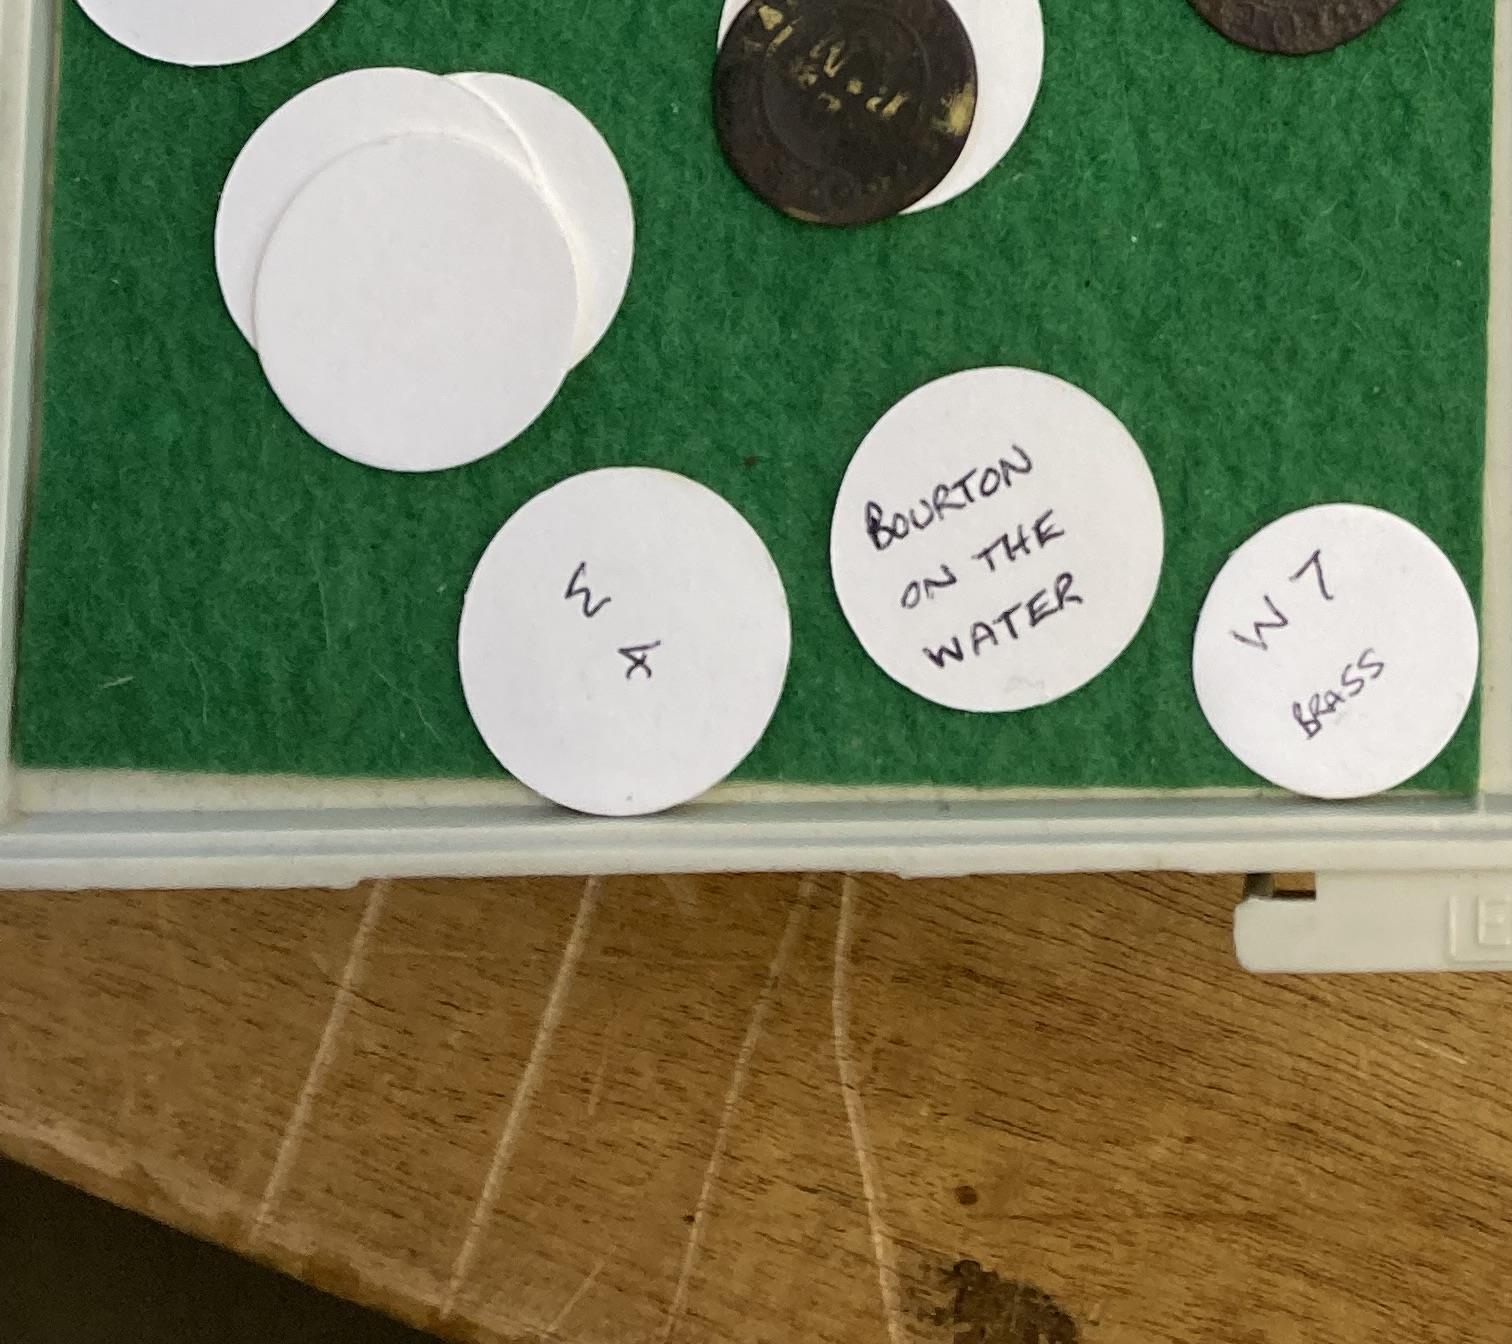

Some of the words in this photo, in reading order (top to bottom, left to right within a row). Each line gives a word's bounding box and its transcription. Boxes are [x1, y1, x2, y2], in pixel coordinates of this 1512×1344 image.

[865, 445, 1033, 550] BOURTON
[564, 561, 612, 619] W
[900, 563, 958, 610] ON
[971, 509, 1066, 569] THE
[1230, 595, 1290, 652] W
[1292, 549, 1336, 602] 7
[922, 572, 1085, 670] WATER
[1291, 647, 1385, 740] BRASS
